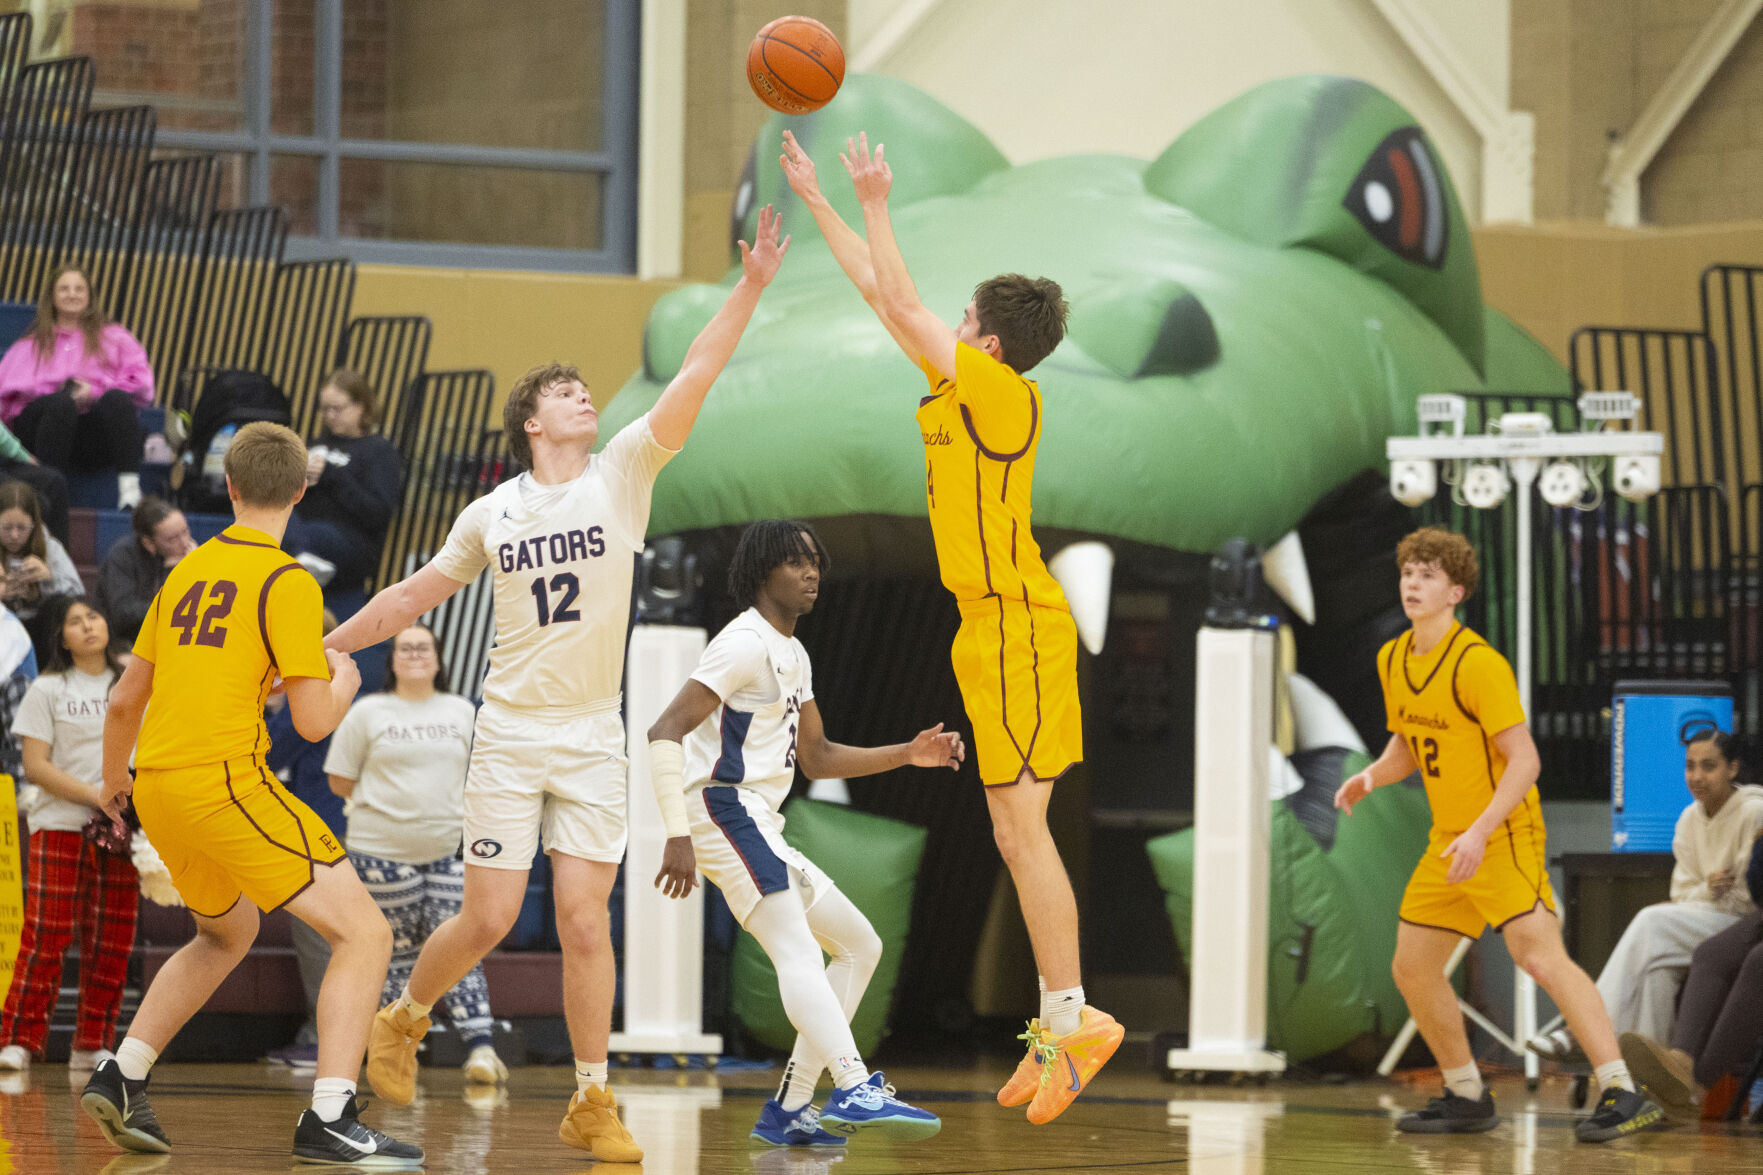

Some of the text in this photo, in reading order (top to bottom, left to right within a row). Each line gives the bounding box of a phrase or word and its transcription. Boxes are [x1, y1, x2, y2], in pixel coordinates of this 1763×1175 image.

[498, 525, 606, 573] GATORS
[170, 579, 238, 648] 42
[530, 572, 581, 627] 12
[388, 723, 460, 741] GATORS
[1411, 736, 1441, 778] 12
